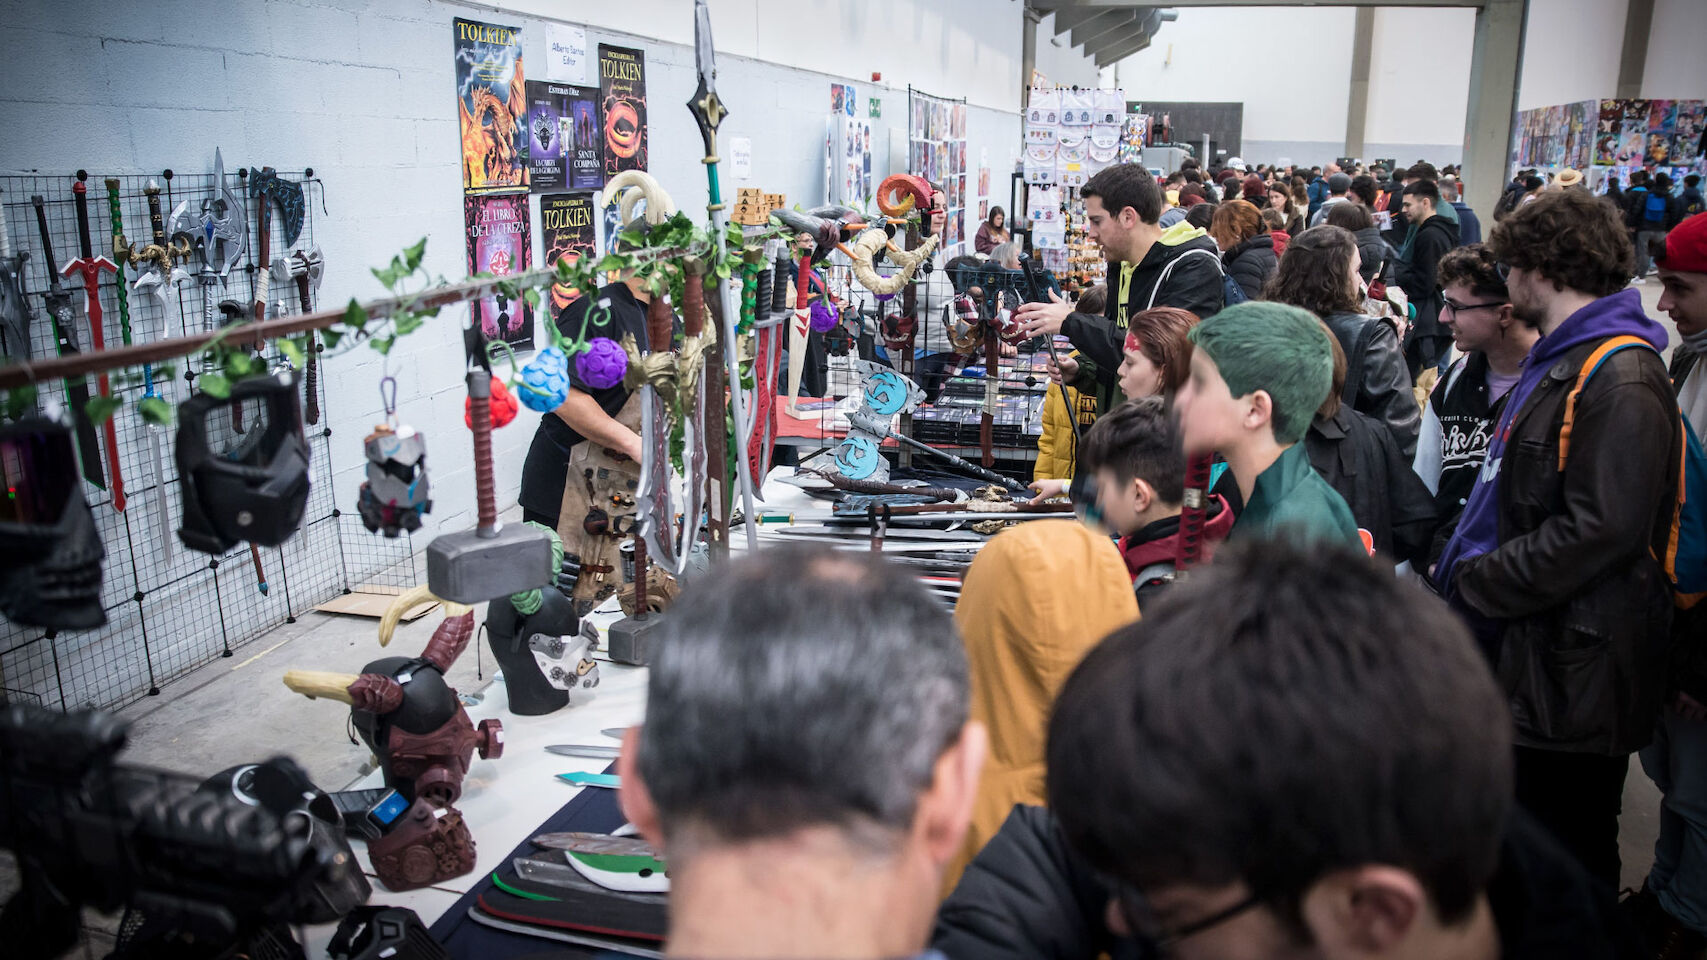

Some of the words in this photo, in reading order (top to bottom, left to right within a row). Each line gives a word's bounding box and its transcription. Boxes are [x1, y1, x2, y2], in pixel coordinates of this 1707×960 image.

[457, 22, 517, 46] TOLKIEN
[601, 58, 641, 81] TOLKIEN
[578, 150, 596, 159] SANTA
[574, 158, 601, 169] COMPAÑA
[483, 209, 491, 222] EL
[493, 207, 516, 221] LIBRO
[544, 207, 591, 230] TOLKIEN
[471, 224, 484, 238] DE
[485, 224, 496, 237] LA
[497, 221, 526, 235] CEREZA
